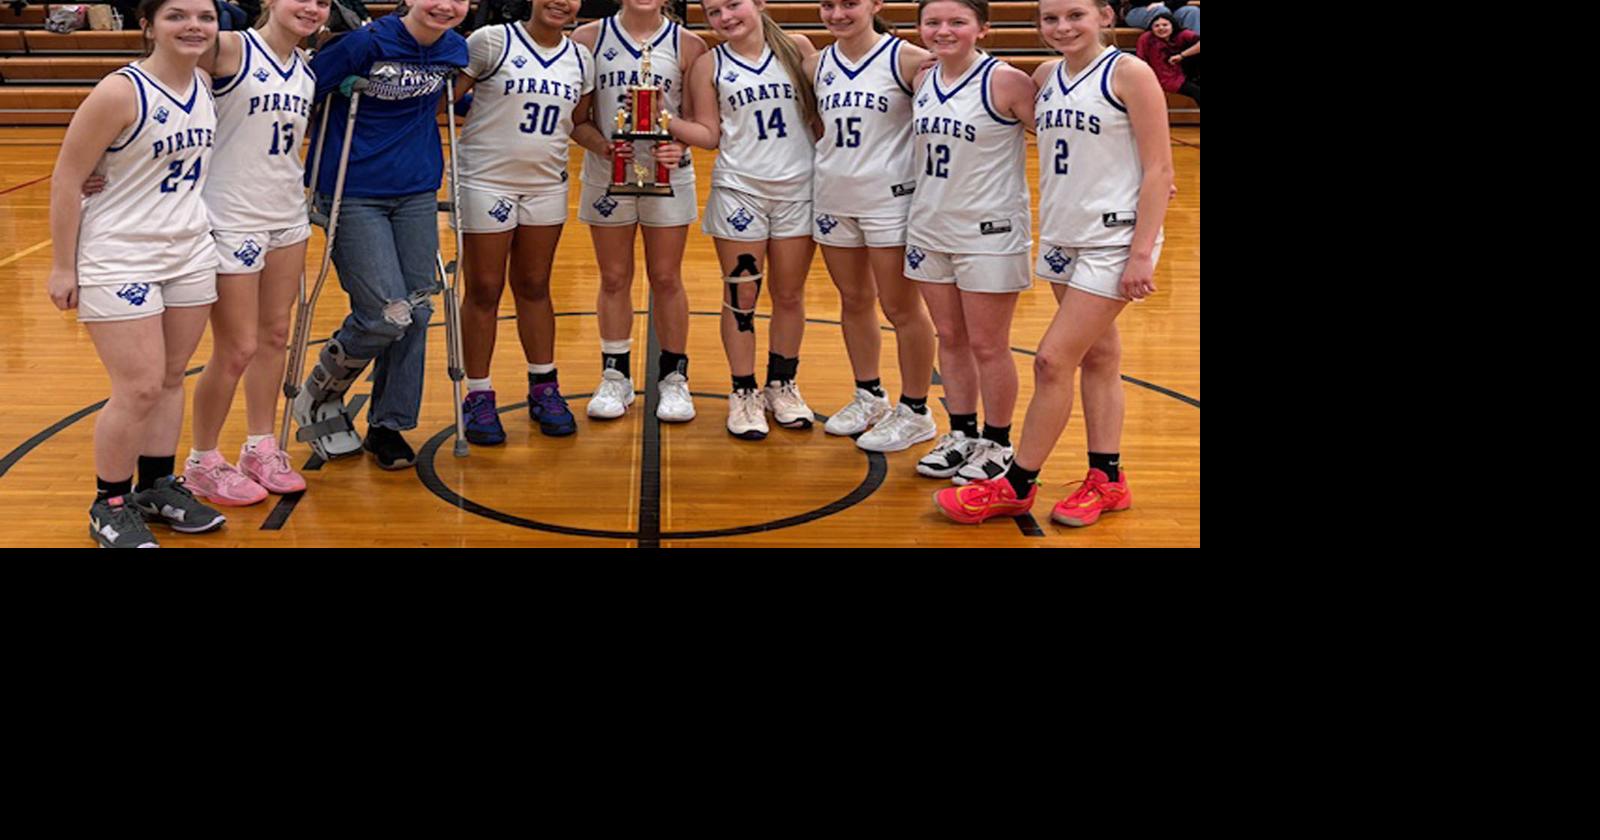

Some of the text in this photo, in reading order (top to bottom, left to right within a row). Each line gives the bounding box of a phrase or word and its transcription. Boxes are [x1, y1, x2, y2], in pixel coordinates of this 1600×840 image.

[519, 101, 561, 136] 30
[754, 107, 788, 141] 14
[834, 117, 862, 148] 15
[160, 155, 202, 193] 24
[925, 142, 951, 179] 12
[1054, 138, 1069, 175] 2
